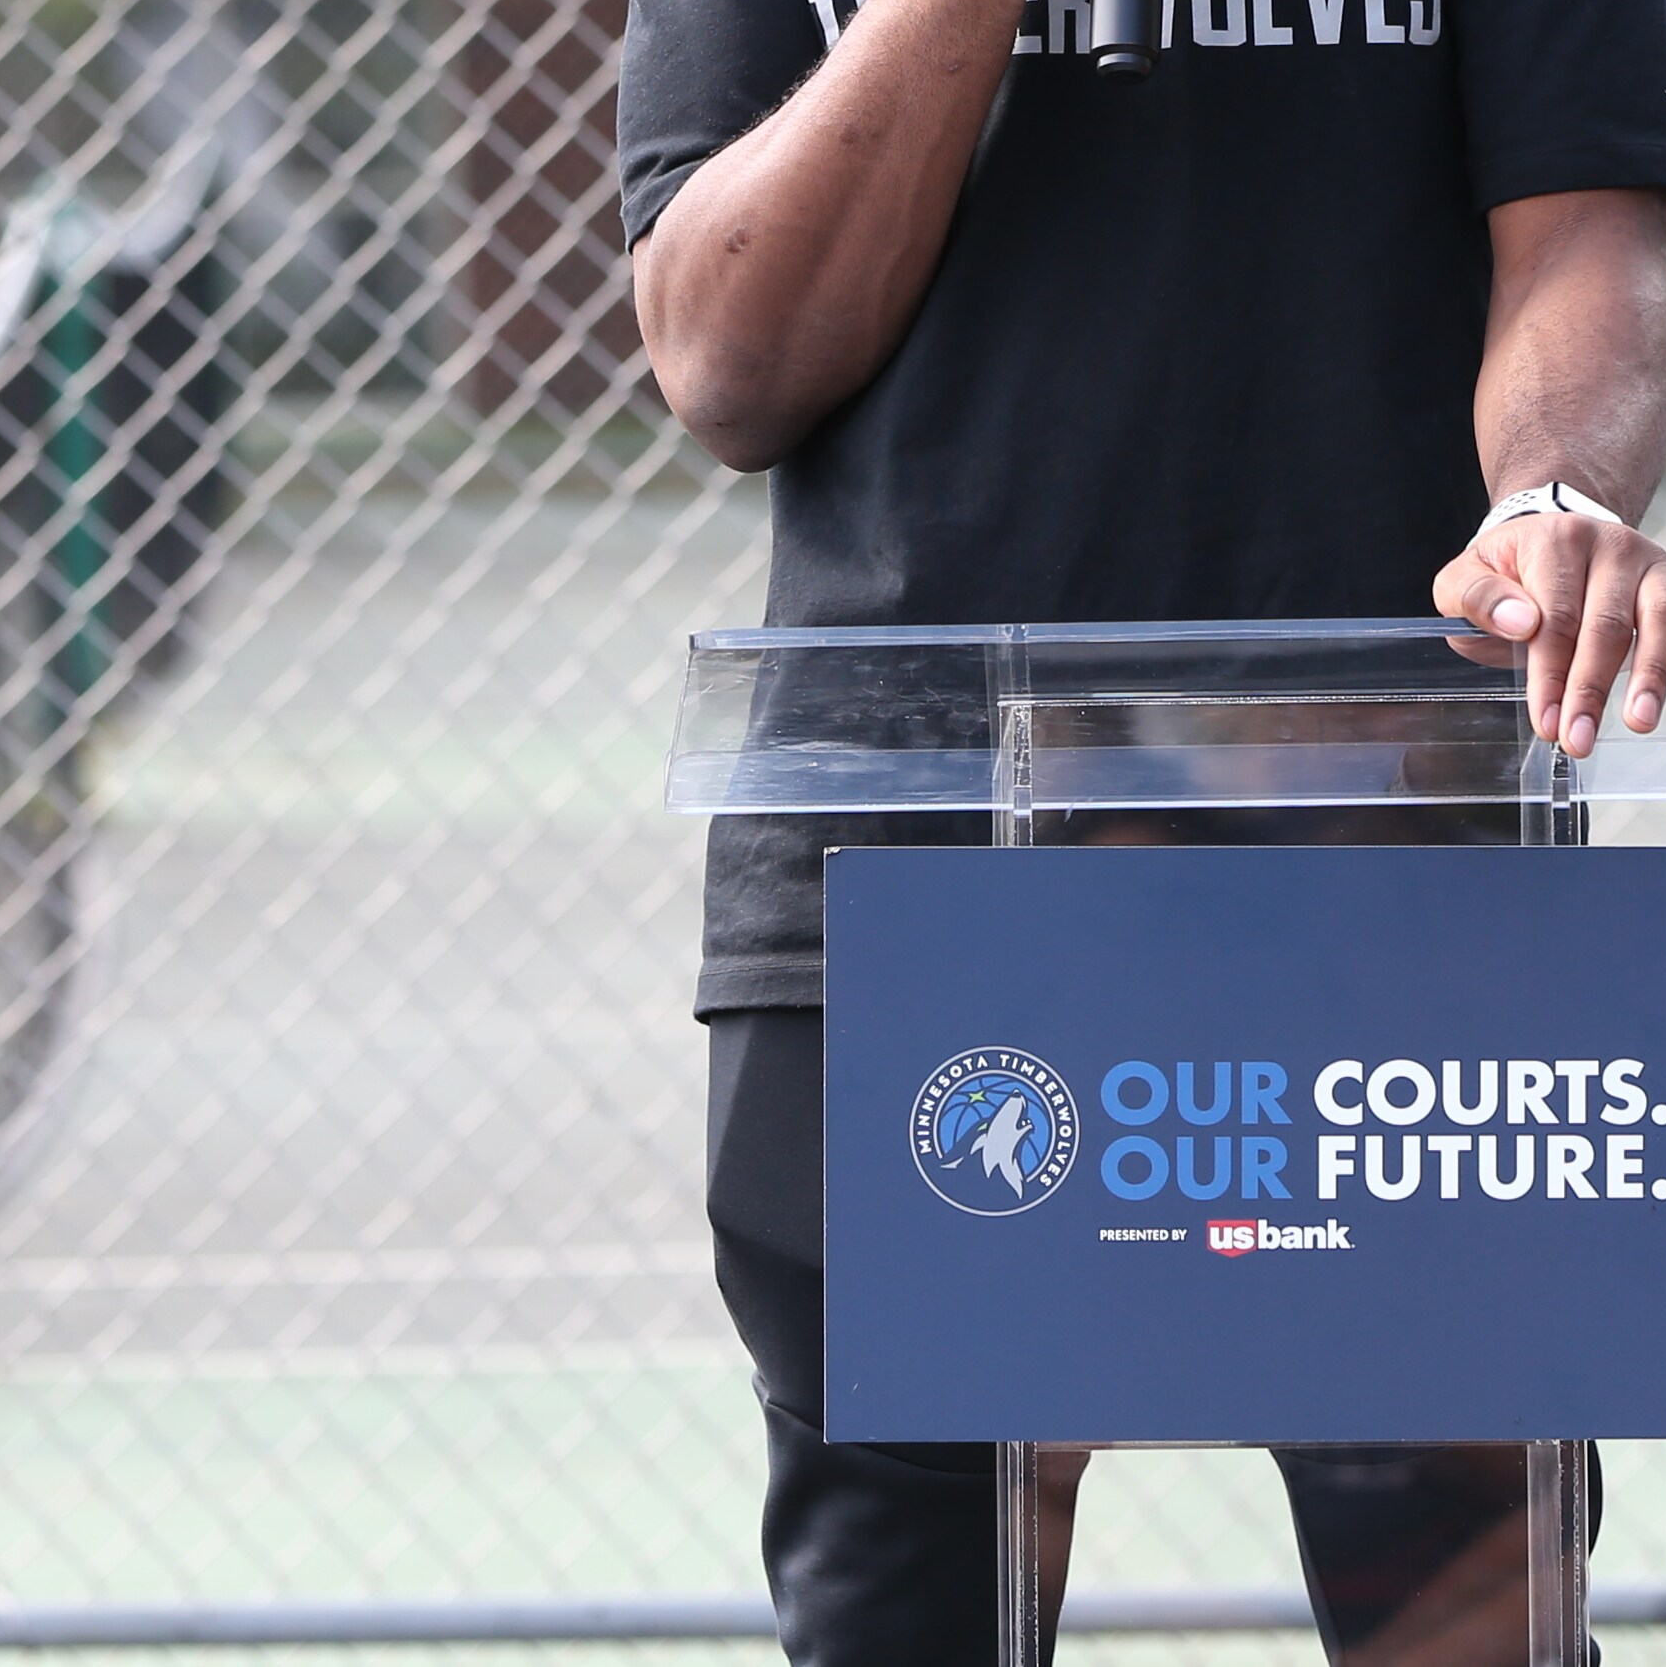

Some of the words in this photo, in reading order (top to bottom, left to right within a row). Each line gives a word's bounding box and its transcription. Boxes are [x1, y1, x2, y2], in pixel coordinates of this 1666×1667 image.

[917, 1055, 988, 1154] MINNESOTA
[999, 1054, 1072, 1186] TIMBERWOLVES
[1100, 1060, 1293, 1125] OUR
[1100, 1135, 1293, 1201] OUR
[1099, 1229, 1169, 1241] PRESENTED
[1171, 1229, 1187, 1241] BY
